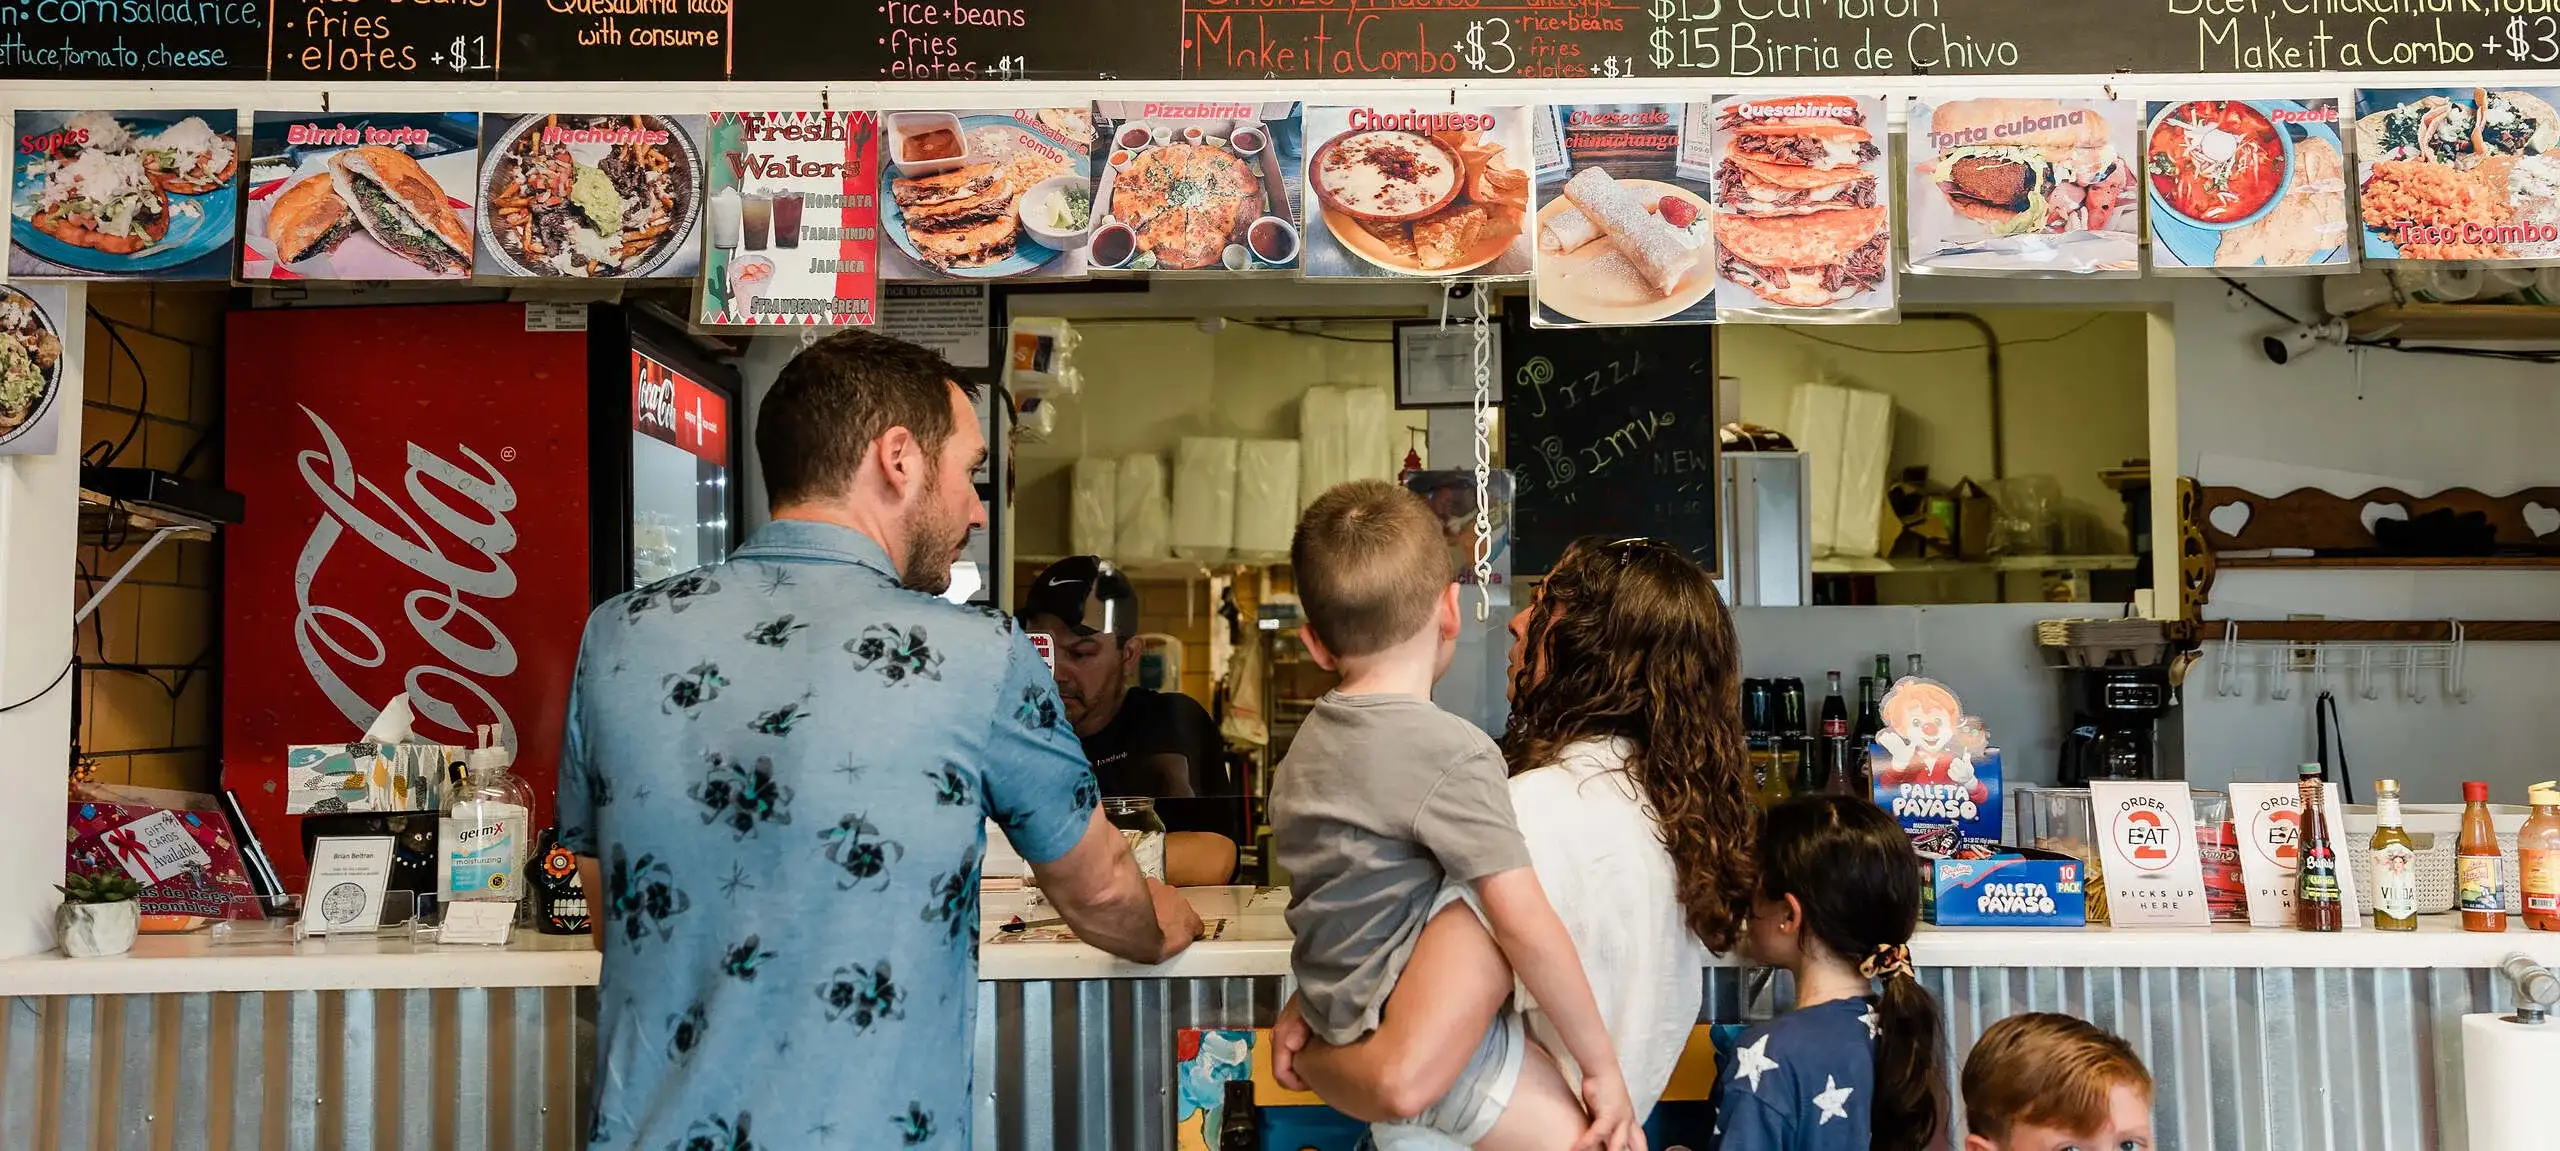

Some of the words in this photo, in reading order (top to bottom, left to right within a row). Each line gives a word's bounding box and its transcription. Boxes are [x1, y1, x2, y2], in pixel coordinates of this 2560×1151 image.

[306, 6, 390, 39] fries
[578, 16, 621, 46] with
[630, 28, 719, 46] consume
[891, 29, 957, 56] fries
[1196, 14, 1295, 71] Make
[1303, 14, 1332, 74] it
[1333, 49, 1355, 73] a
[1355, 15, 1457, 73] Combo
[1530, 36, 1581, 57] fries
[1649, 26, 1720, 69] $15
[1730, 22, 1840, 76] Birria
[1854, 27, 1893, 70] de
[1907, 23, 2018, 70] Chivo
[2199, 16, 2302, 71] Make
[2308, 19, 2334, 68] it
[2340, 43, 2362, 67] a
[2367, 16, 2474, 65] Combo
[301, 39, 417, 71] elotes
[891, 56, 977, 80] elotes
[1524, 57, 1588, 79] elotes
[1143, 102, 1252, 121] Pizzabirria
[1568, 108, 1671, 126] Cheesecake
[1737, 102, 1854, 120] Quesabirrias
[2271, 107, 2339, 124] Pozole
[740, 116, 847, 142] Fresh
[1347, 107, 1496, 137] Choriqueso
[1927, 126, 1988, 150] Torta
[1997, 109, 2086, 141] cubana
[20, 124, 90, 155] Sopes
[287, 122, 359, 146] Birria
[364, 124, 429, 146] torta
[542, 126, 669, 146] Nachofries
[1565, 132, 1680, 151] chimichanga
[1019, 134, 1064, 164] combo
[726, 151, 862, 180] Waters
[2395, 220, 2456, 246] Taco
[2461, 218, 2558, 244] Combo
[1900, 782, 1970, 801] PALETA
[1892, 798, 1978, 821] PAYASO
[2121, 797, 2165, 812] ORDER
[2260, 797, 2300, 811] ORDE
[144, 821, 166, 837] GIFT
[2128, 827, 2170, 845] EAT
[2269, 827, 2300, 844] EA
[148, 831, 180, 849] CARDS
[152, 843, 200, 869] Available
[2059, 865, 2075, 881] 10
[162, 886, 184, 898] de
[1984, 882, 2048, 898] PALETA
[2058, 882, 2081, 894] PACK
[140, 902, 221, 914] sponibles
[1977, 896, 2056, 914] PAYASO
